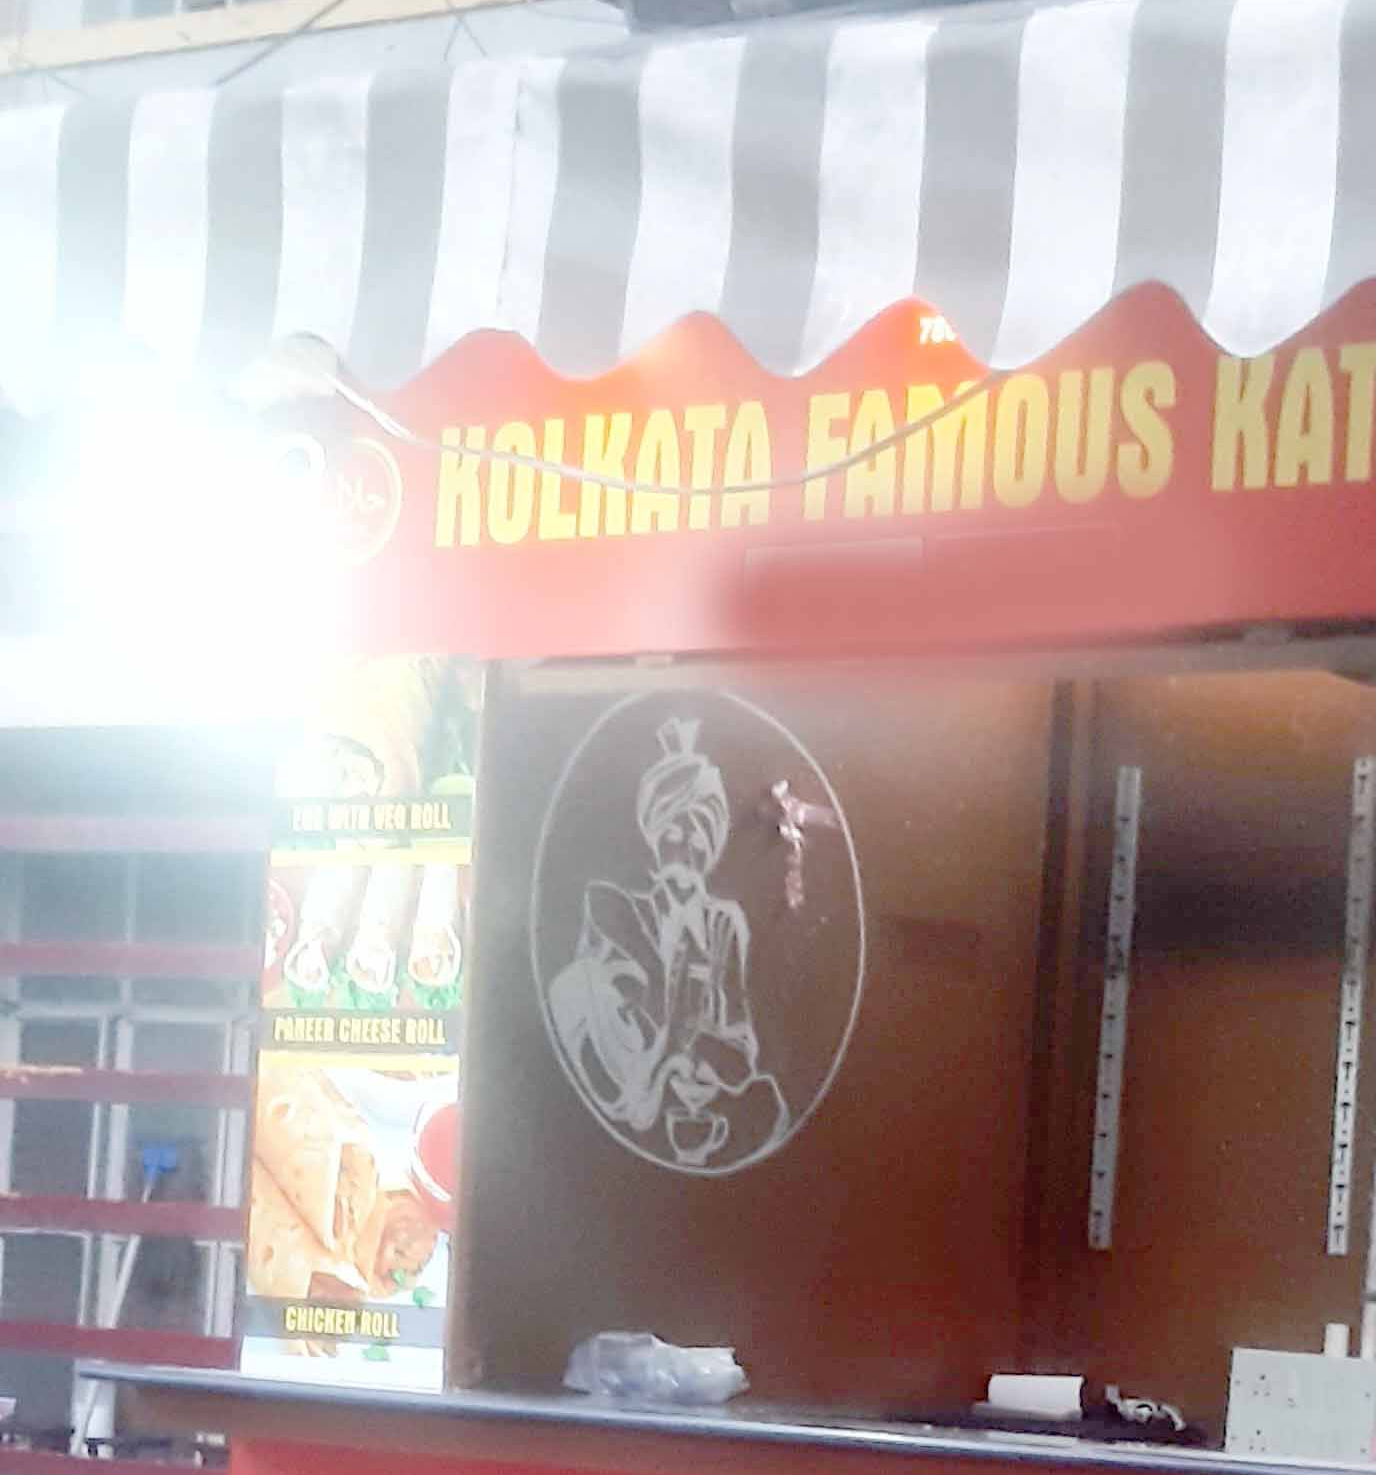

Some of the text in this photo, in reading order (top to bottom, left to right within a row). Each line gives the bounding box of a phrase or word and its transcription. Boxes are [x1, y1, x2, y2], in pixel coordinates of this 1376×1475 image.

[434, 401, 772, 549] KOLKATA
[804, 361, 1177, 522] FAMOUS
[411, 802, 452, 830] ROLL
[338, 1018, 401, 1044] CHEESE
[405, 1020, 446, 1045] ROLL
[285, 1306, 400, 1338] CHICKEN ROLL
